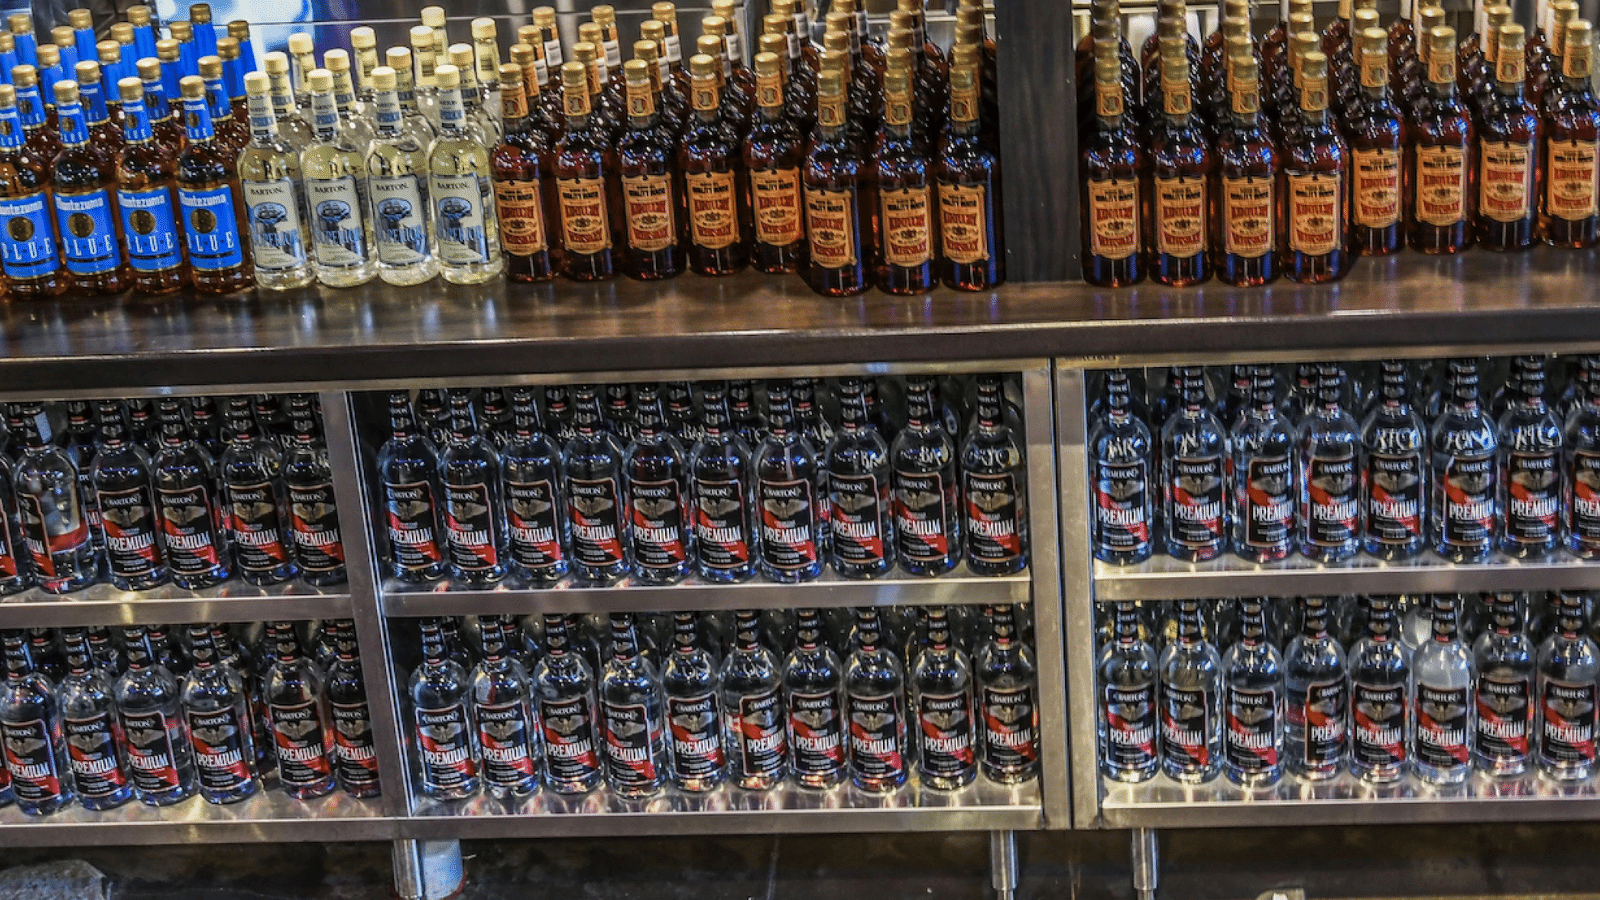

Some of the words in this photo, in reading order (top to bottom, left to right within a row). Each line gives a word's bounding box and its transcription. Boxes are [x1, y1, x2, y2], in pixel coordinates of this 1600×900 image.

[1175, 501, 1220, 520] PREMIUM
[1370, 498, 1418, 518] PREMIUM
[1449, 499, 1494, 519] PREMIUM
[1511, 495, 1558, 517] PREMIUM
[1099, 506, 1144, 525] PREMIUM
[510, 526, 553, 543] PREMIUM
[572, 523, 616, 540] PREMIUM
[634, 525, 679, 543] PREMIUM
[699, 525, 742, 542] PREMIUM
[764, 524, 809, 543] PREMIUM
[832, 518, 876, 538] PREMIUM
[899, 517, 941, 534] PREMIUM
[969, 517, 1013, 534] PREMIUM
[107, 531, 154, 550] PREMIUM
[164, 530, 210, 550] PREMIUM
[234, 527, 279, 545] PREMIUM
[295, 527, 338, 545] PREMIUM
[987, 728, 1032, 746] PREMIUM
[1109, 724, 1154, 744] PREMIUM
[1228, 727, 1272, 748] PREMIUM
[1356, 725, 1401, 744] PREMIUM
[1418, 726, 1464, 745] PREMIUM
[1478, 720, 1525, 738] PREMIUM
[1545, 724, 1591, 743] PREMIUM
[547, 739, 592, 757] PREMIUM
[675, 735, 720, 752] PREMIUM
[796, 731, 840, 751] PREMIUM
[852, 737, 896, 753] PREMIUM
[925, 733, 969, 752] PREMIUM
[197, 750, 242, 768] PREMIUM
[278, 743, 323, 760] PREMIUM
[425, 747, 469, 764] PREMIUM
[483, 743, 528, 761] PREMIUM
[606, 745, 648, 762] PREMIUM
[72, 755, 117, 774] PREMIUM
[128, 753, 169, 769] PREMIUM
